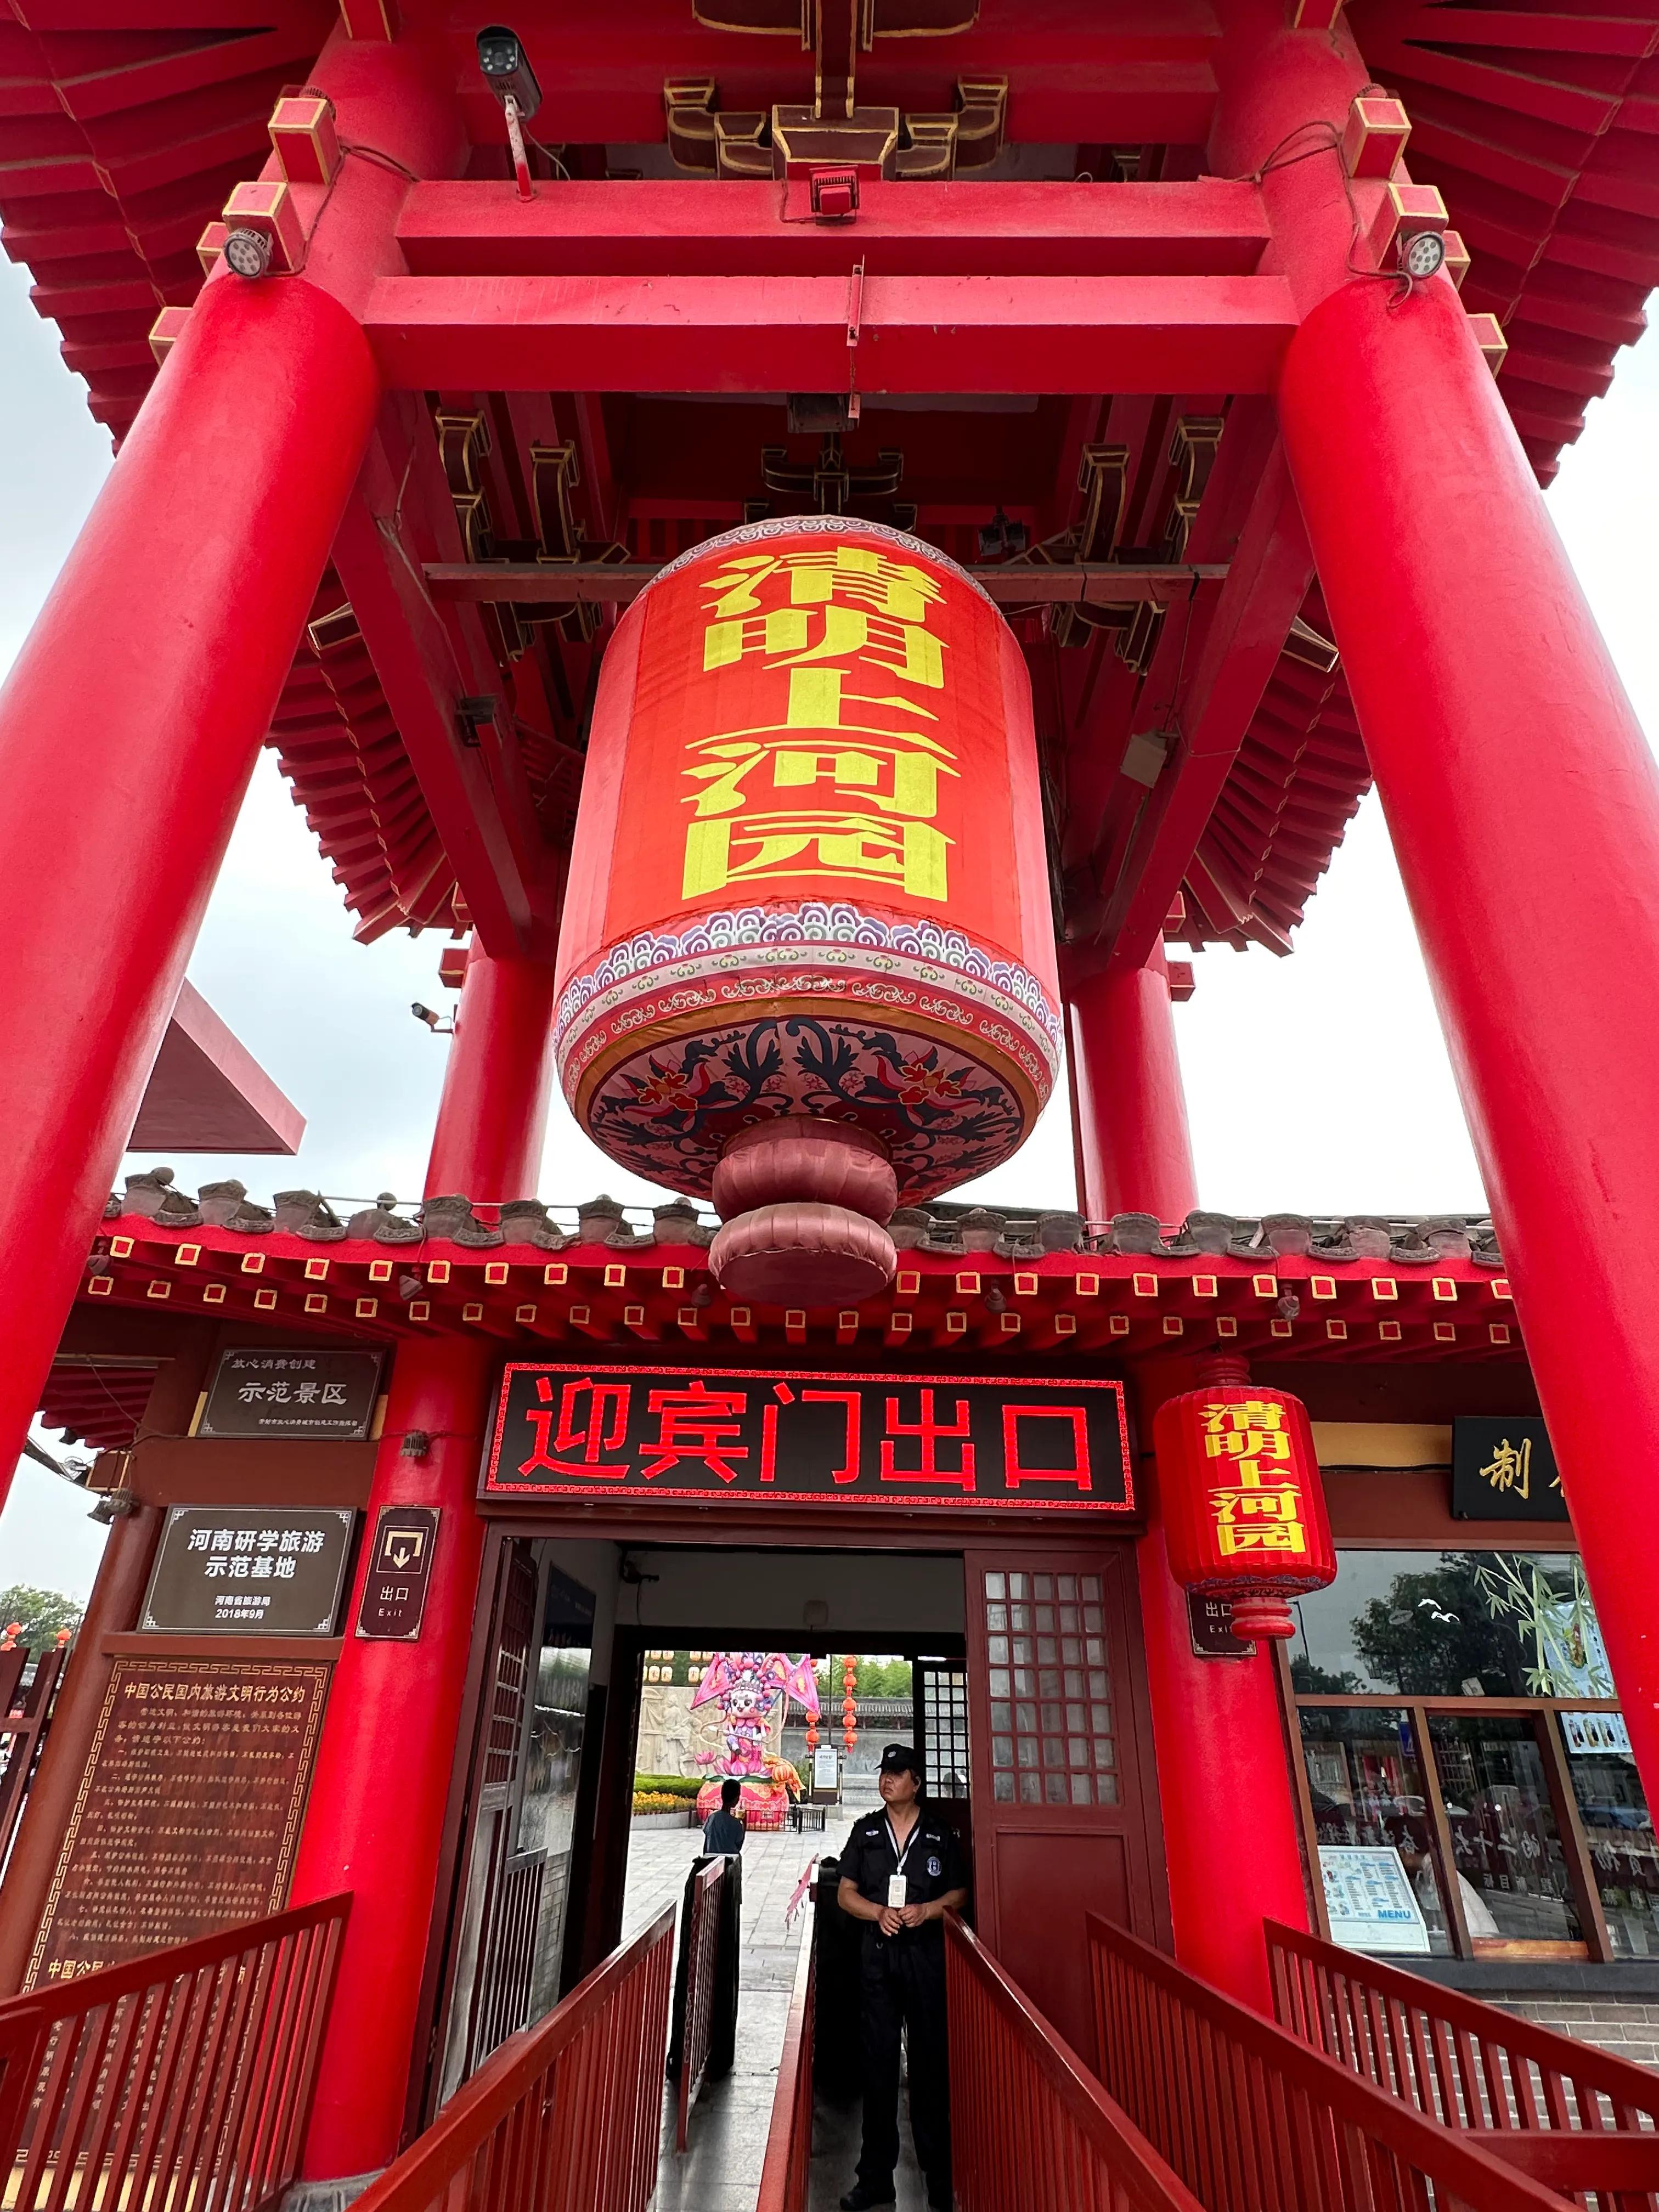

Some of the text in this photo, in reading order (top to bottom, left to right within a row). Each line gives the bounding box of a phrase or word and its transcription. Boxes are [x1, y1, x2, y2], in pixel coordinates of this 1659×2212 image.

[680, 546, 961, 902] 清明上河园
[231, 1358, 316, 1370] 放心消费创建
[238, 1380, 347, 1405] 示范景区
[518, 1376, 1092, 1492] 迎宾门出口
[1198, 1400, 1306, 1556] 清明上河园
[1480, 1438, 1565, 1499] 制
[187, 1528, 326, 1553] 河南研学旅游
[204, 1555, 296, 1578] 示范基地
[215, 1595, 271, 1607] 河南省旅游局
[380, 1585, 409, 1601] 出口
[215, 1609, 264, 1620] 2018年9月
[378, 1607, 403, 1617] Exit
[1205, 1601, 1232, 1617] 出口
[1209, 1625, 1232, 1633] Exi
[124, 1681, 306, 1703] 中国公民国内旅游文明行为公约
[1378, 1910, 1411, 1919] MENU
